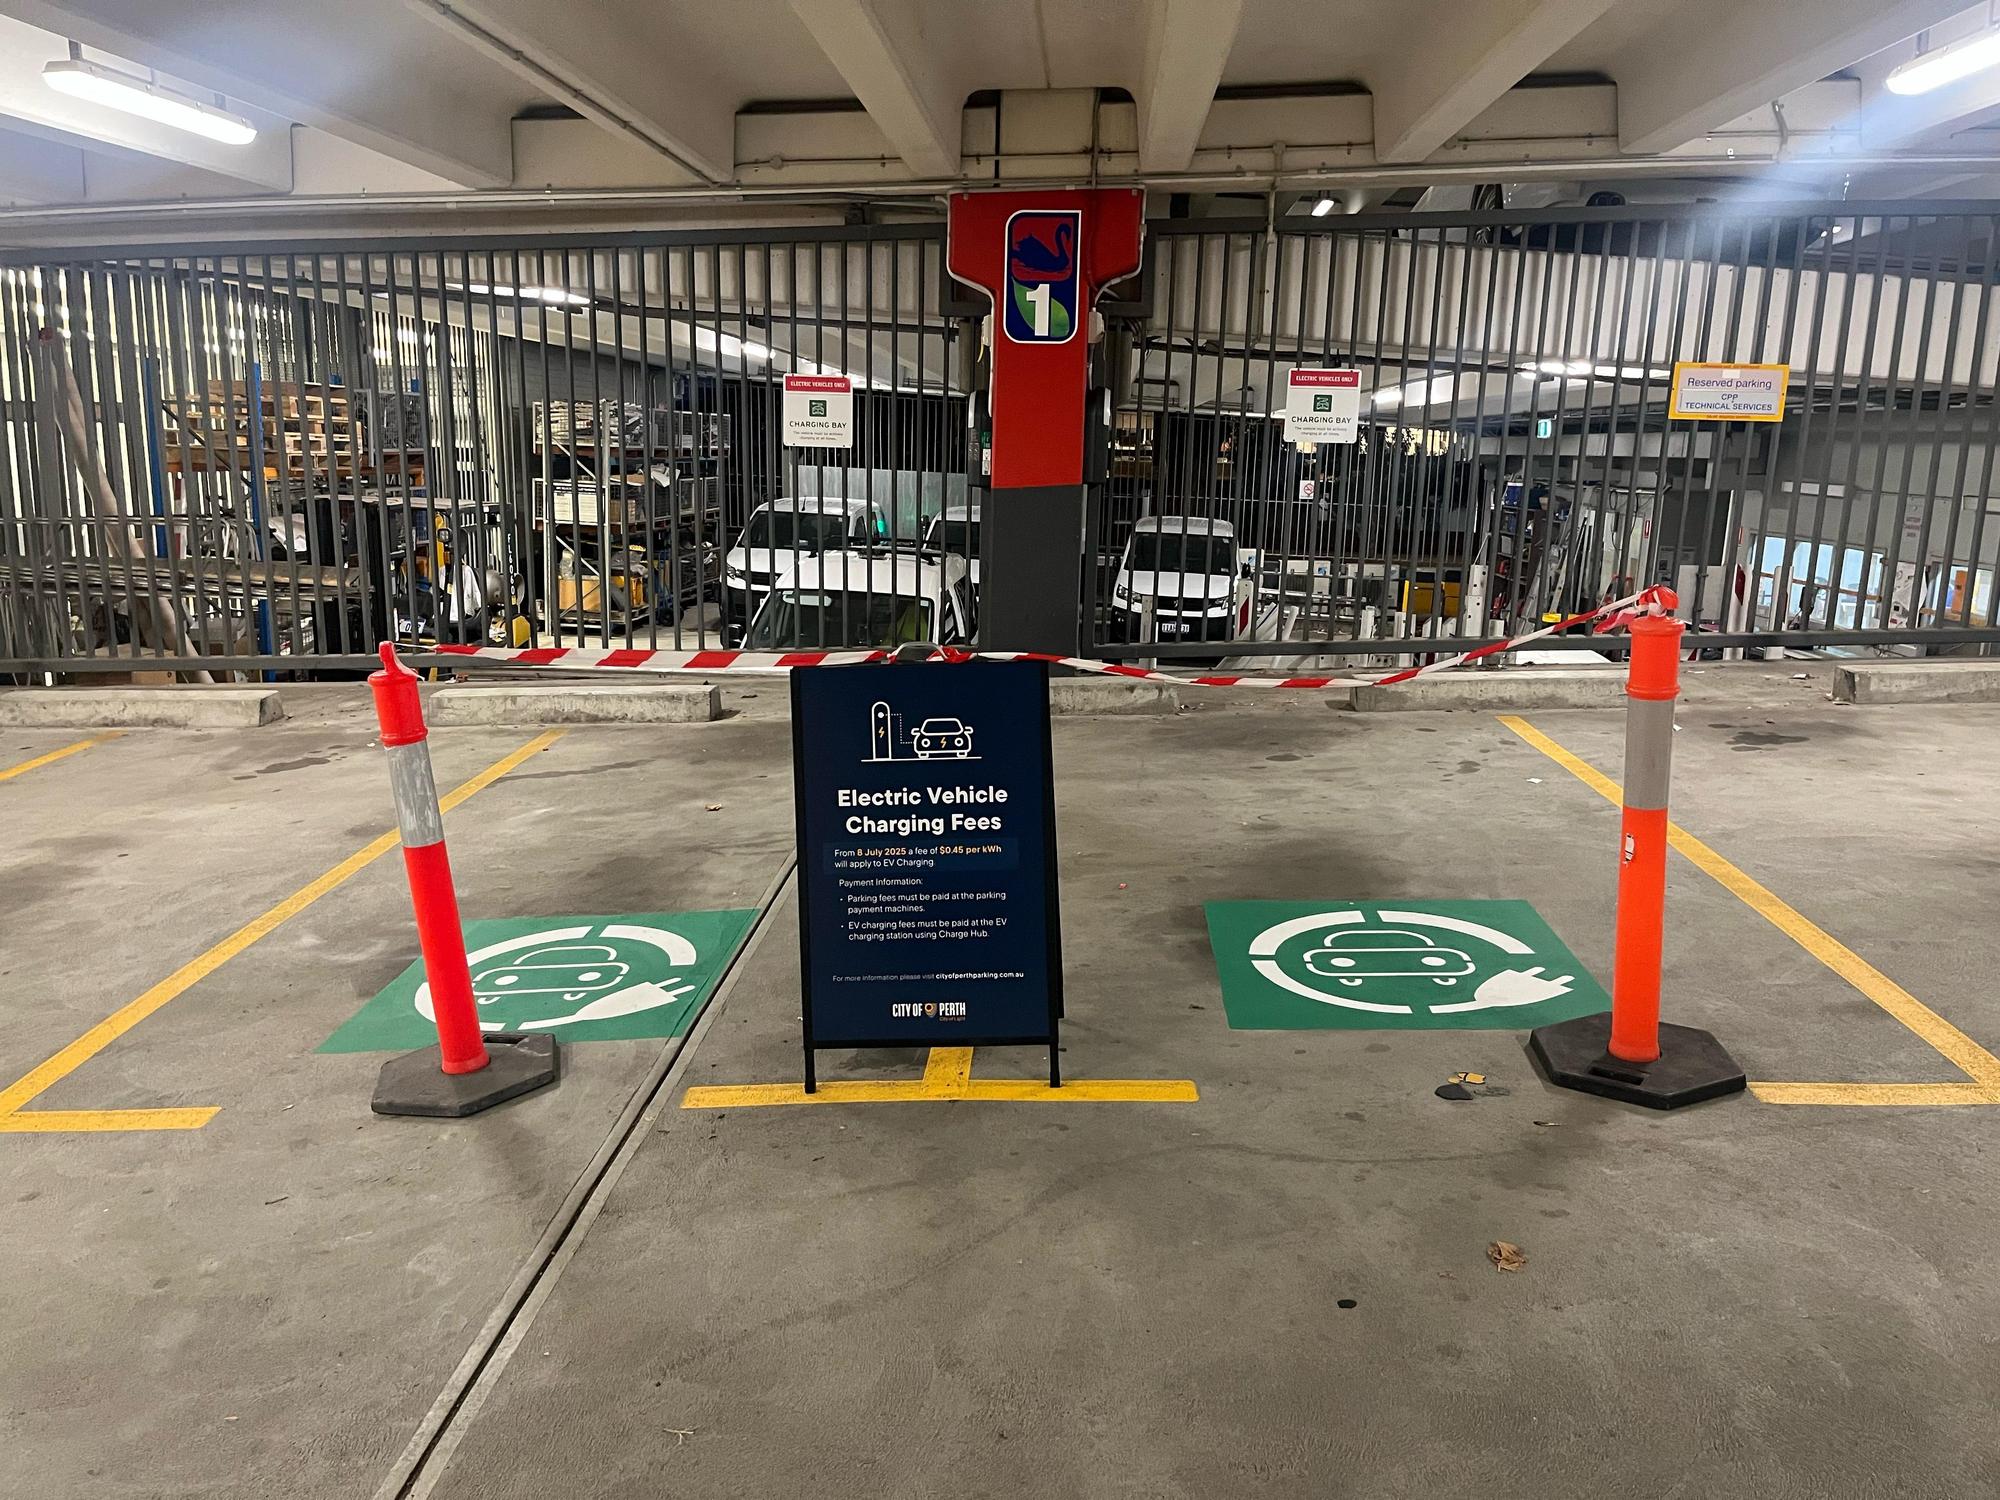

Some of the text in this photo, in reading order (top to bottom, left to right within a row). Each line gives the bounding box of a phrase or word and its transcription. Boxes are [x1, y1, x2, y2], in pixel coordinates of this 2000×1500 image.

[1026, 283, 1051, 337] 1
[1687, 377, 1772, 390] Reserved parking
[1721, 393, 1738, 401] CPP
[1685, 402, 1773, 411] TECHNICAL SERVICES
[838, 785, 1008, 808] Electric Vehicle
[846, 813, 1002, 837] Charging Fees
[834, 848, 856, 858] From
[857, 848, 863, 857] 8
[865, 848, 883, 858] July
[884, 847, 907, 856] 2025
[915, 847, 928, 855] fee
[929, 846, 938, 855] of
[939, 845, 964, 855] $0.45
[966, 846, 981, 856] per
[982, 844, 1002, 854] kWh
[834, 860, 848, 868] will
[850, 860, 872, 870] apply
[873, 859, 882, 867] to
[883, 859, 895, 867] EV
[839, 878, 923, 888] Payment Information:
[847, 894, 878, 904] Parking
[879, 894, 897, 902] fees
[919, 893, 931, 901] be
[932, 892, 950, 901] paid
[951, 892, 960, 900] at
[960, 892, 975, 900] the
[976, 891, 1007, 901] parking
[847, 904, 926, 915] payment machines.
[848, 921, 860, 929] EV
[861, 921, 897, 931] charging
[898, 920, 916, 928] fees
[917, 920, 938, 928] must
[939, 919, 950, 927] be
[951, 918, 969, 928] paid
[980, 918, 994, 926] the
[995, 918, 1008, 926] EV
[848, 929, 990, 942] charging station using Charge Hub.
[862, 974, 899, 982] information
[900, 973, 921, 981] please
[935, 971, 1024, 981] cityofperthparking.com.au
[892, 1002, 966, 1018] CITY OF PERTH
